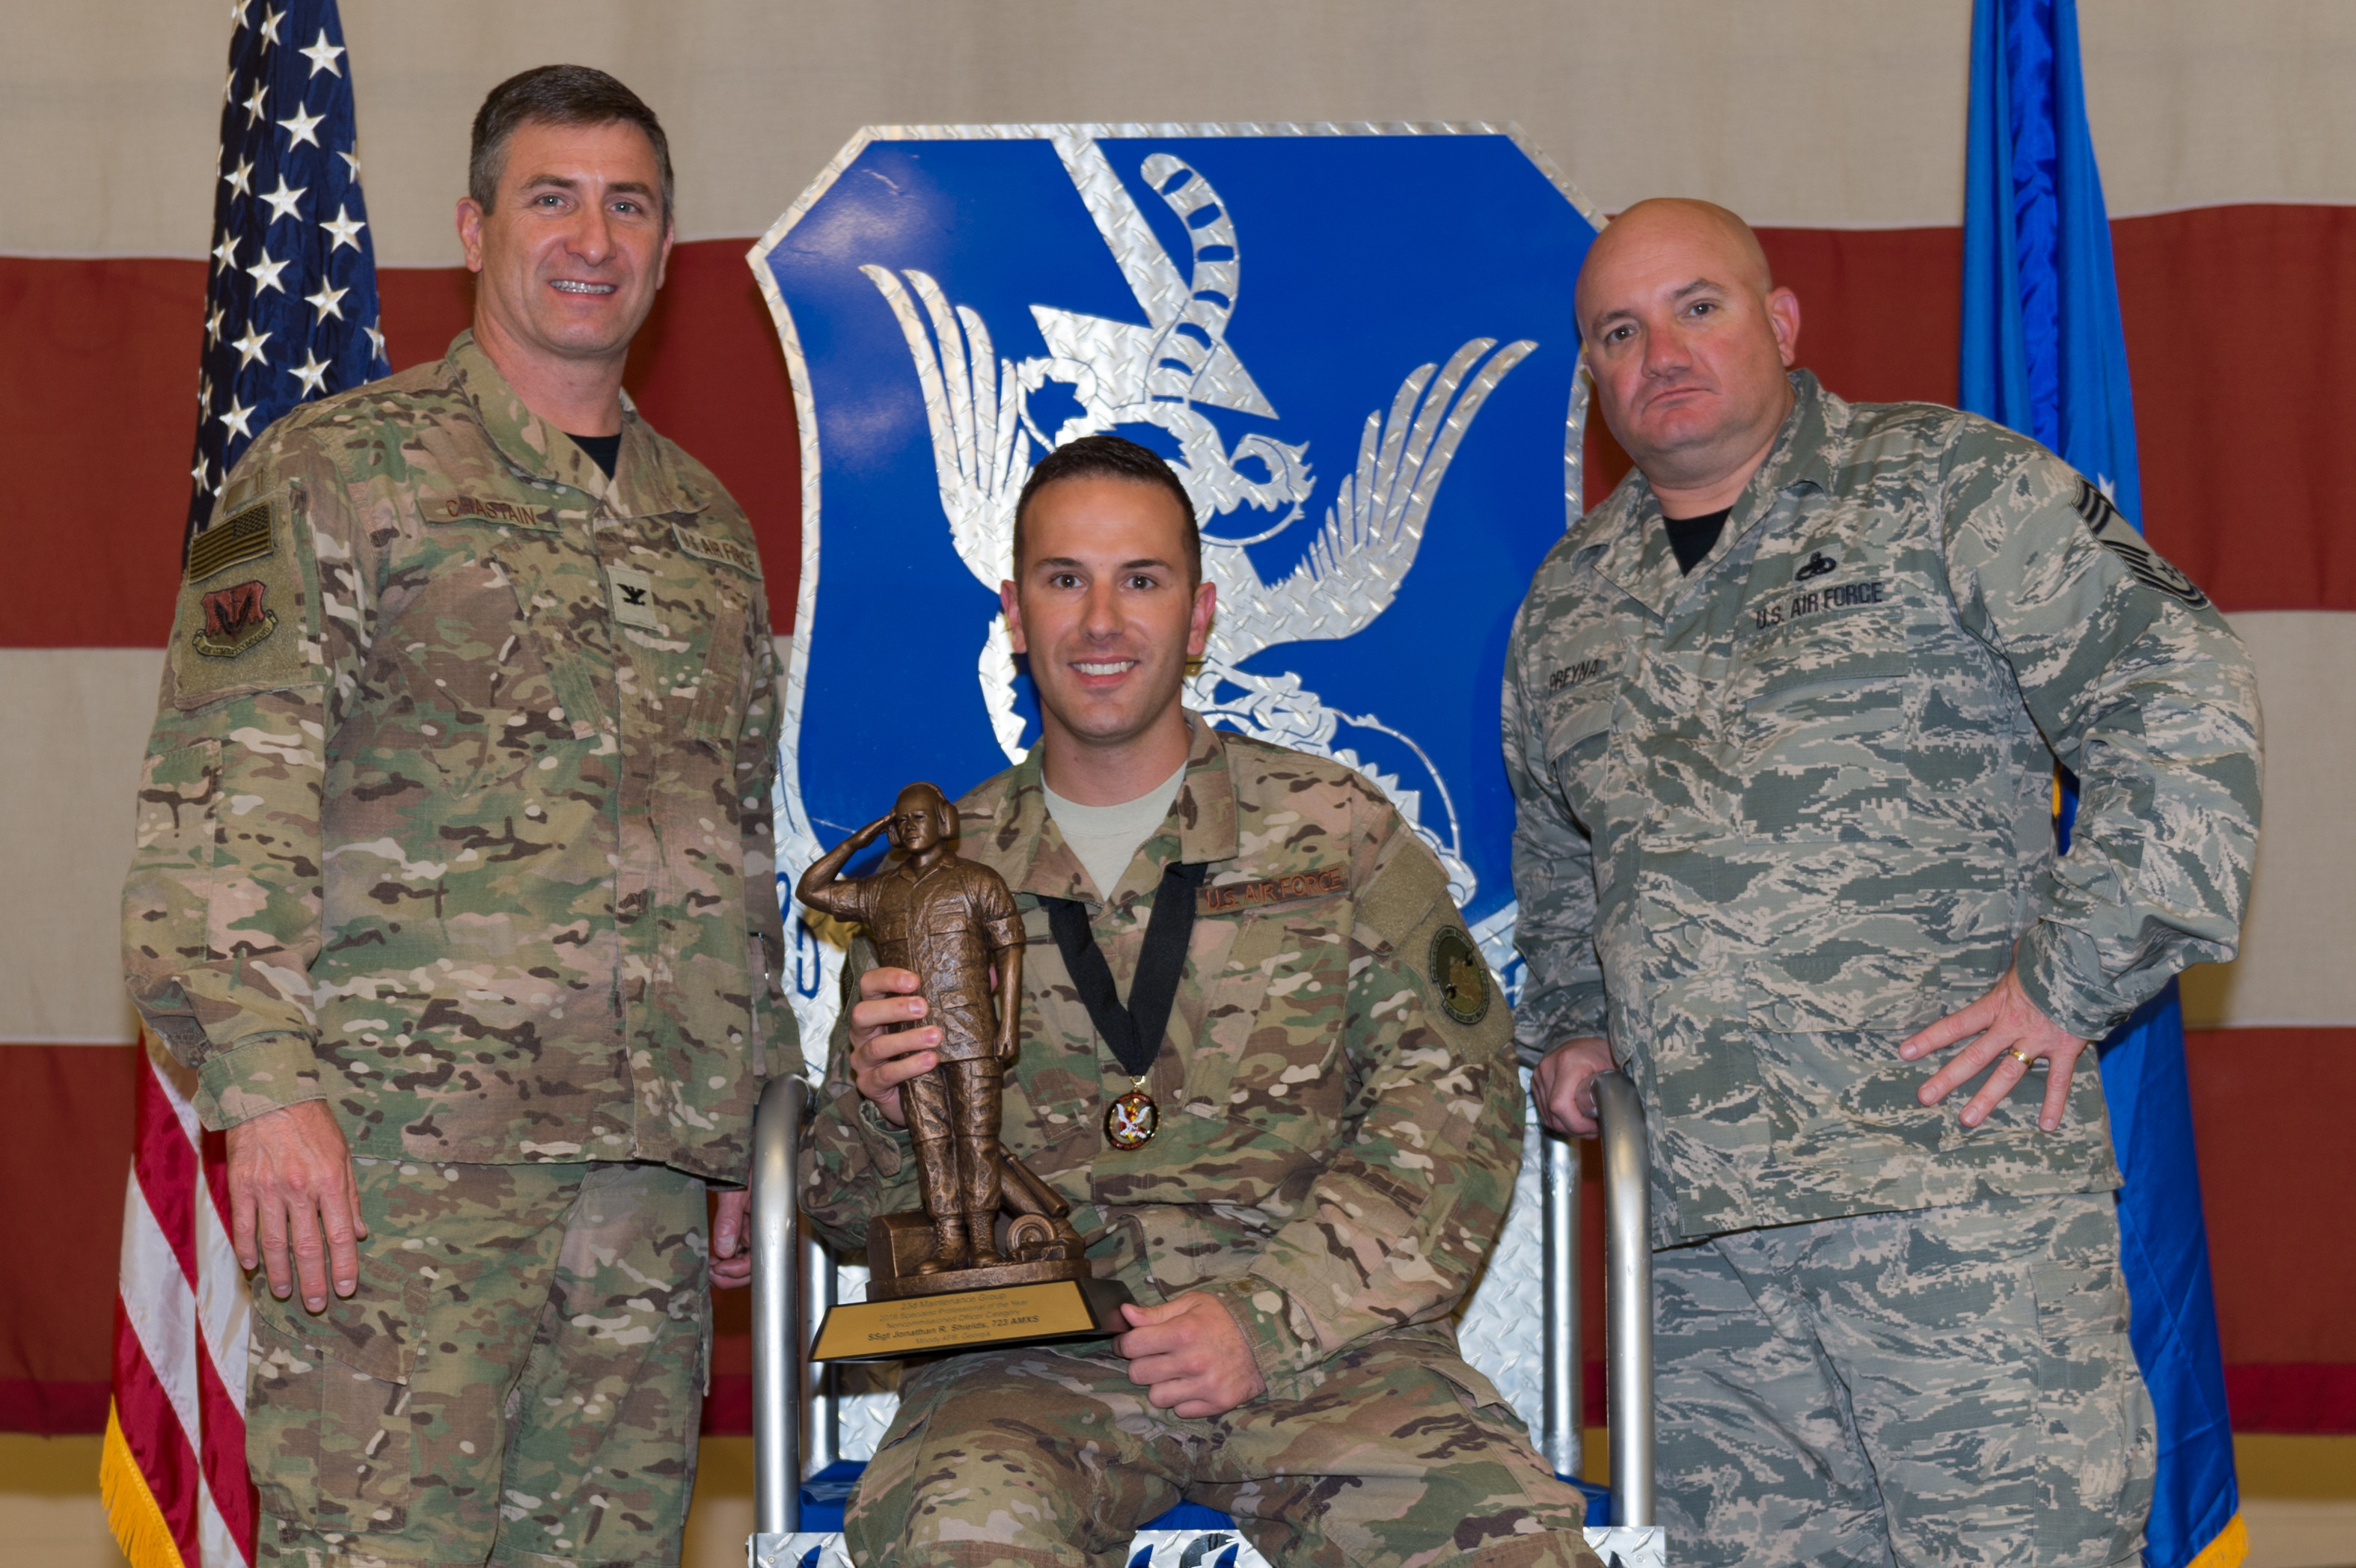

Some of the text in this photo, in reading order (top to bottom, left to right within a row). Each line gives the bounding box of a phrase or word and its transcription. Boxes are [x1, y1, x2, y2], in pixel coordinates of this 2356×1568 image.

[446, 497, 536, 525] CHASTAIN
[700, 538, 724, 558] AIR
[721, 542, 756, 572] FORCE
[1757, 582, 1882, 630] U.S. AIR FORCE
[1206, 868, 1343, 910] U.S. AIR FORCE
[868, 1332, 890, 1341] SSgt
[991, 1318, 1009, 1327] 723
